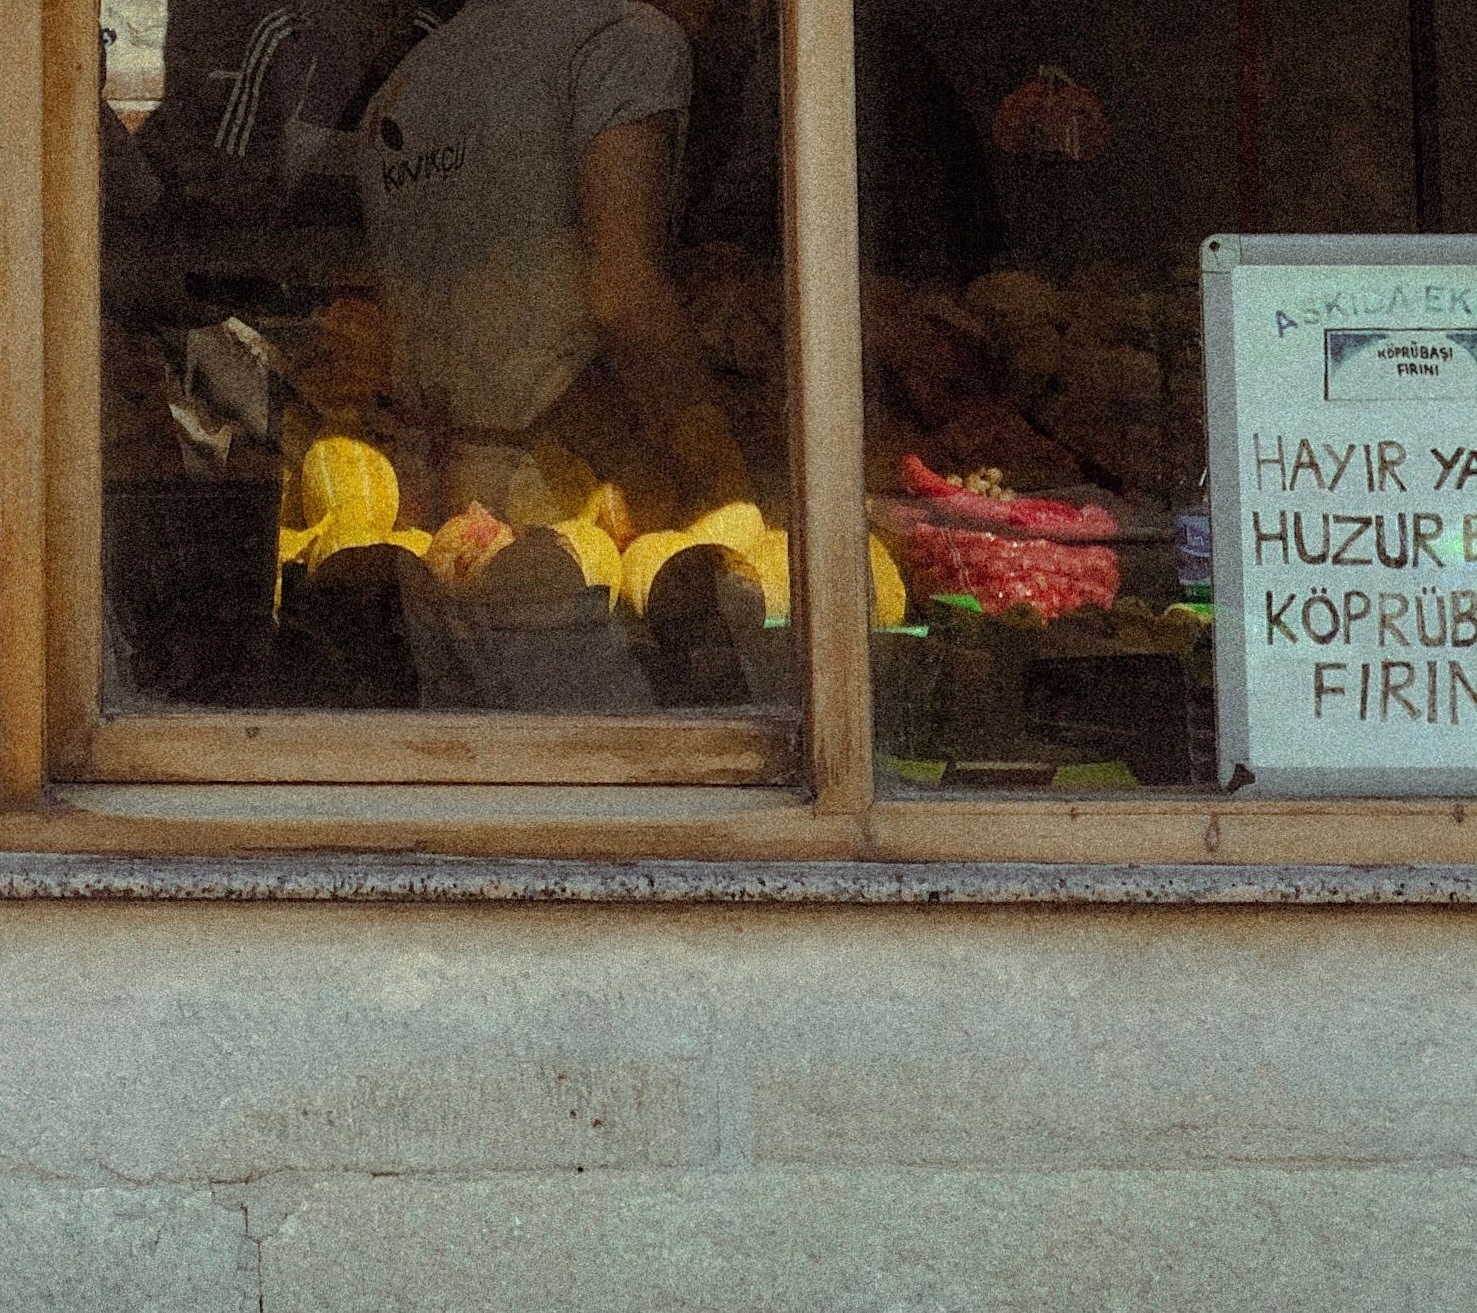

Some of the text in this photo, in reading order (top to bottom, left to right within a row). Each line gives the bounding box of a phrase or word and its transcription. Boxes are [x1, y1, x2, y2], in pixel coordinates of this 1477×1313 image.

[1377, 341, 1454, 362] KÖPRÜBAŞI
[1396, 362, 1439, 377] FIRINI
[1252, 432, 1408, 493] HAYIR
[1252, 509, 1445, 568] HUZUR
